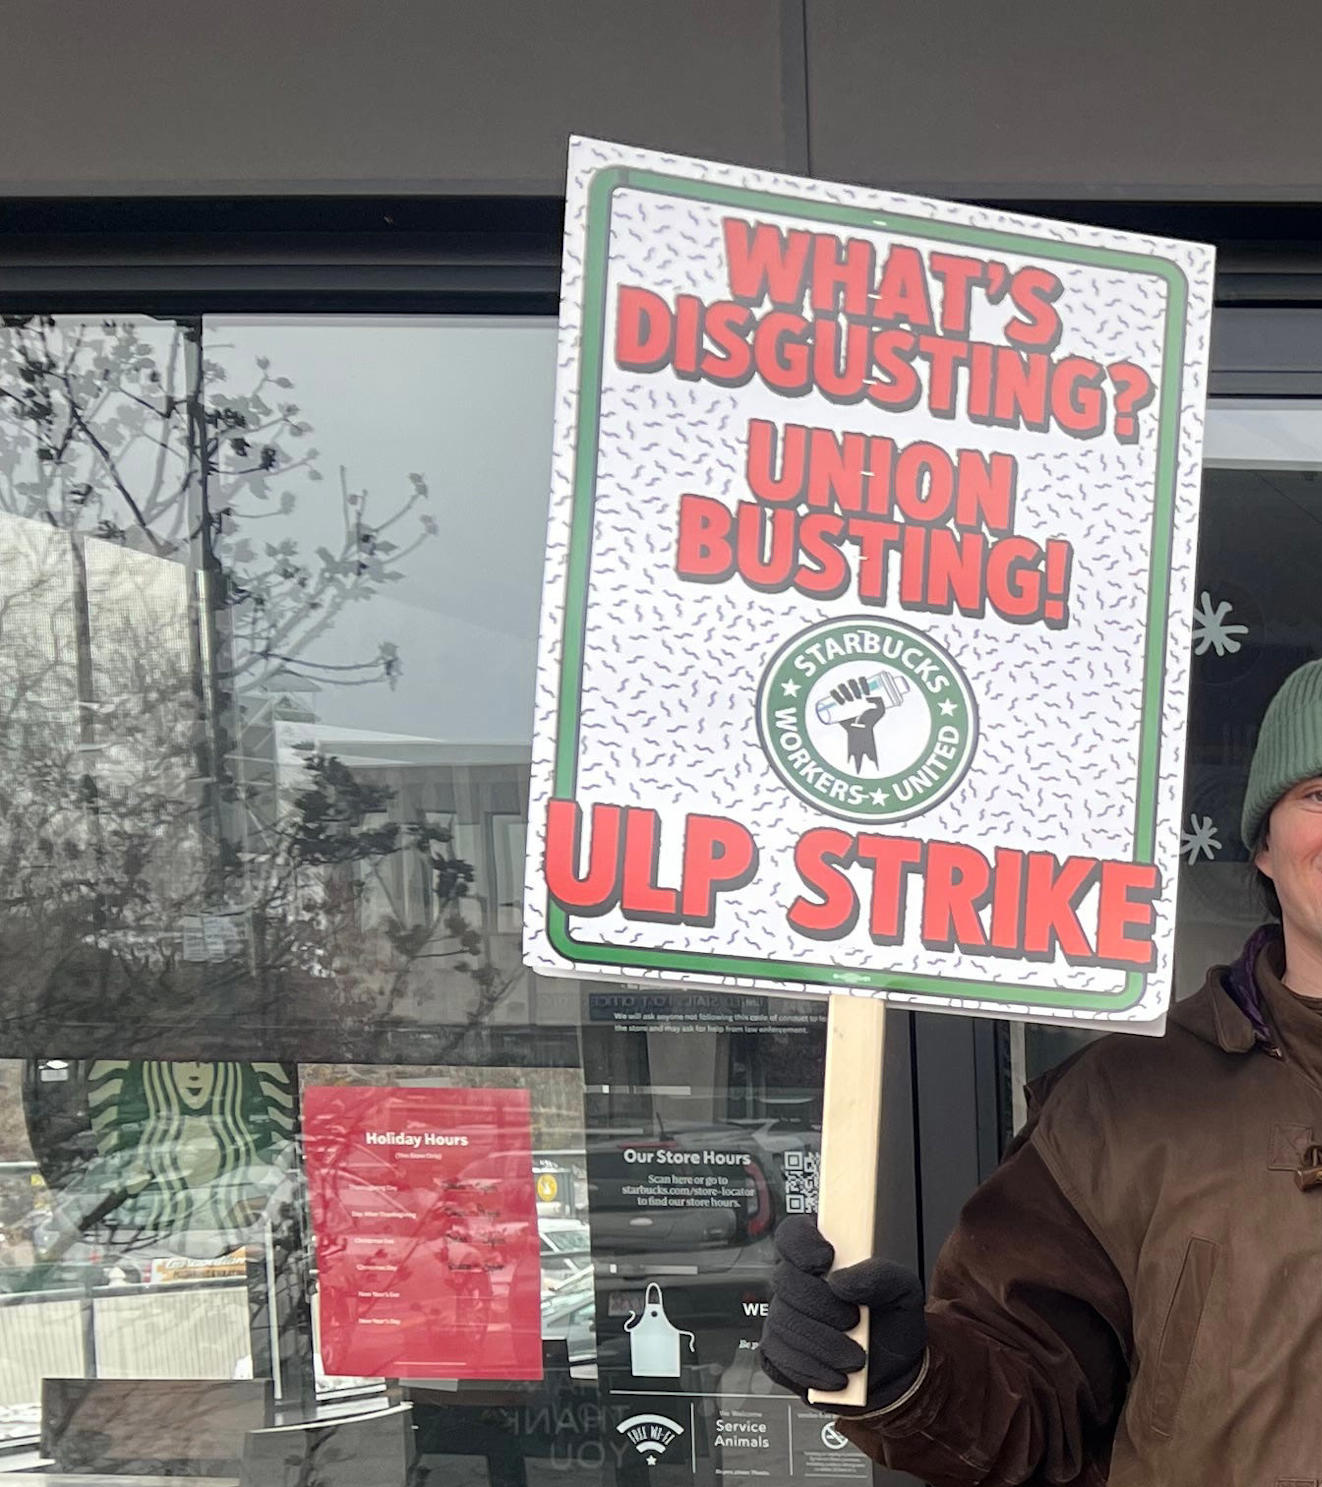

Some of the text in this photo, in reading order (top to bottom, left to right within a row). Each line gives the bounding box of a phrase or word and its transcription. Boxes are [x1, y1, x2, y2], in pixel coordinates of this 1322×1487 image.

[722, 217, 1064, 348] WHAT'S
[614, 284, 1155, 444] DISGUSTING?
[746, 418, 1018, 534] UNION
[675, 493, 1071, 629] BUSTING!
[794, 629, 949, 693] STARBUCKS
[775, 707, 959, 805] WORKERS UNITED
[545, 798, 1159, 972] ULP STRIKE
[366, 1131, 469, 1148] Holiday Hours
[623, 1149, 751, 1165] Our Store Hours
[648, 1174, 728, 1187] Scan here or go to
[622, 1186, 755, 1197] starbucks.com/store-locator
[638, 1197, 741, 1208] to find our store hours.
[627, 1426, 648, 1444] FREE
[716, 1419, 767, 1433] Service
[714, 1434, 770, 1448] Animals
